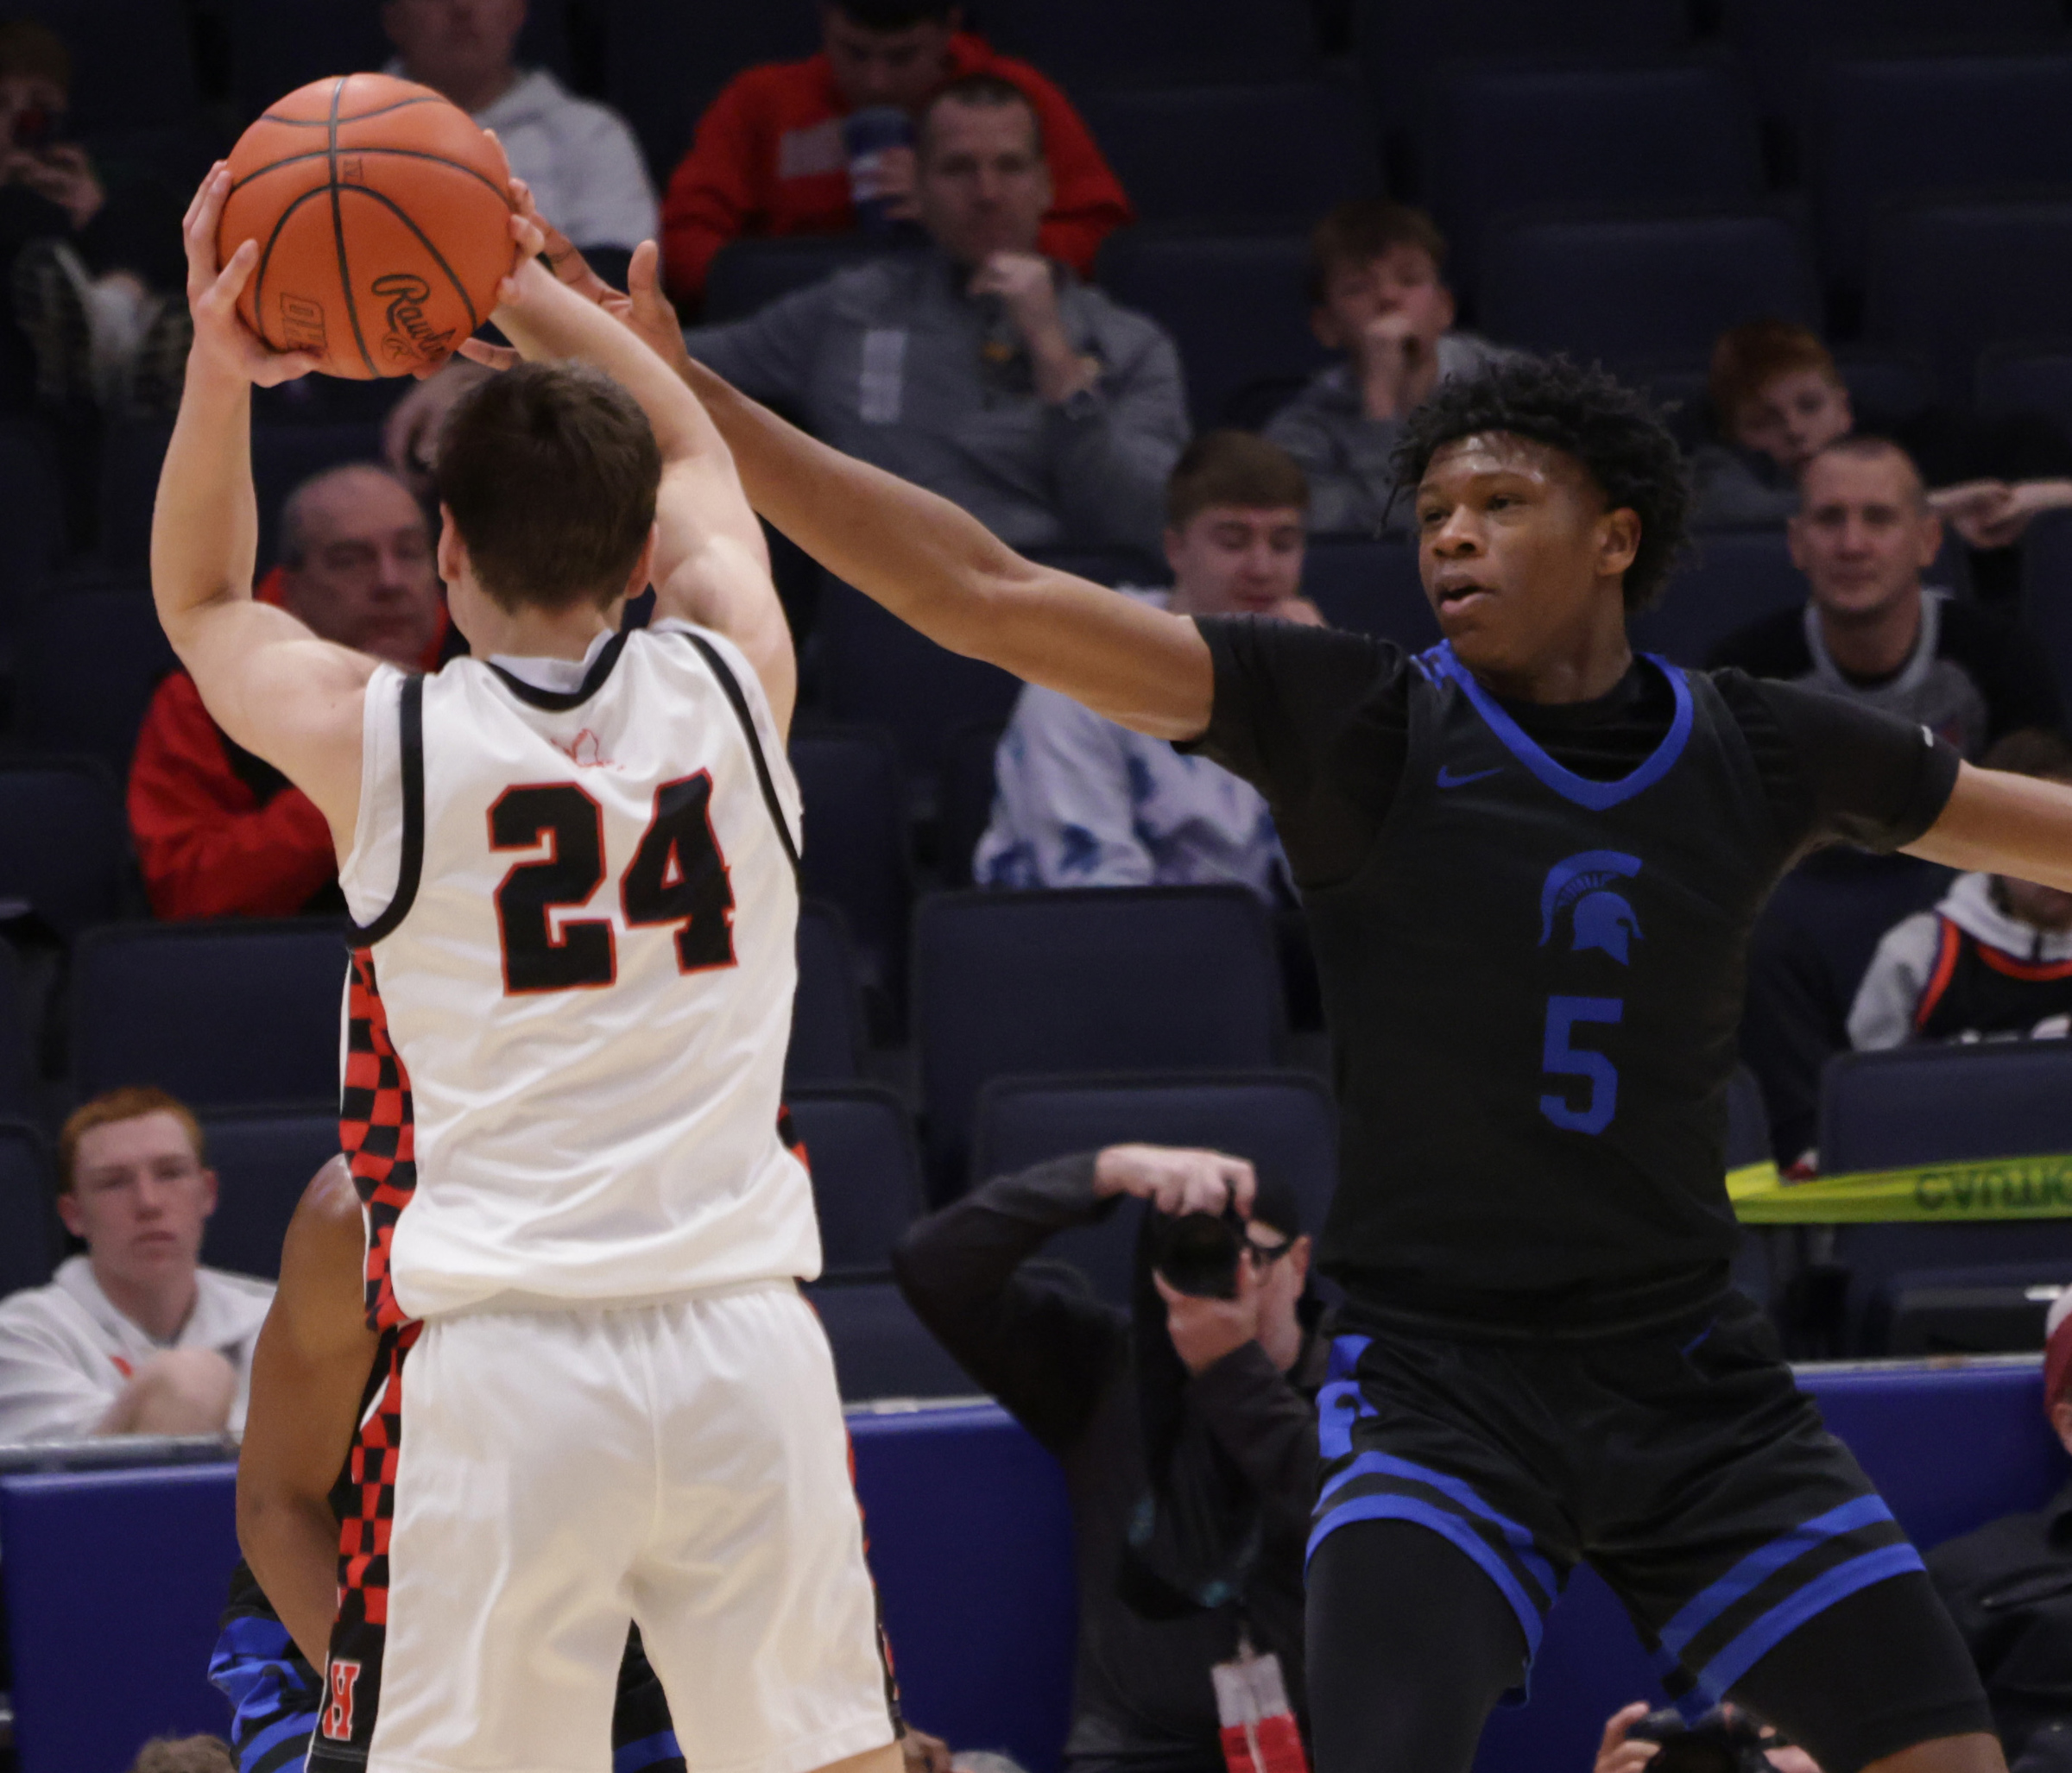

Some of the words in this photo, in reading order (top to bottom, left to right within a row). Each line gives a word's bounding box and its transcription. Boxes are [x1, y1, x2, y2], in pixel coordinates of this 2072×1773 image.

[485, 767, 738, 998] 24
[1539, 995, 1624, 1136] 5
[321, 1658, 361, 1741] H
